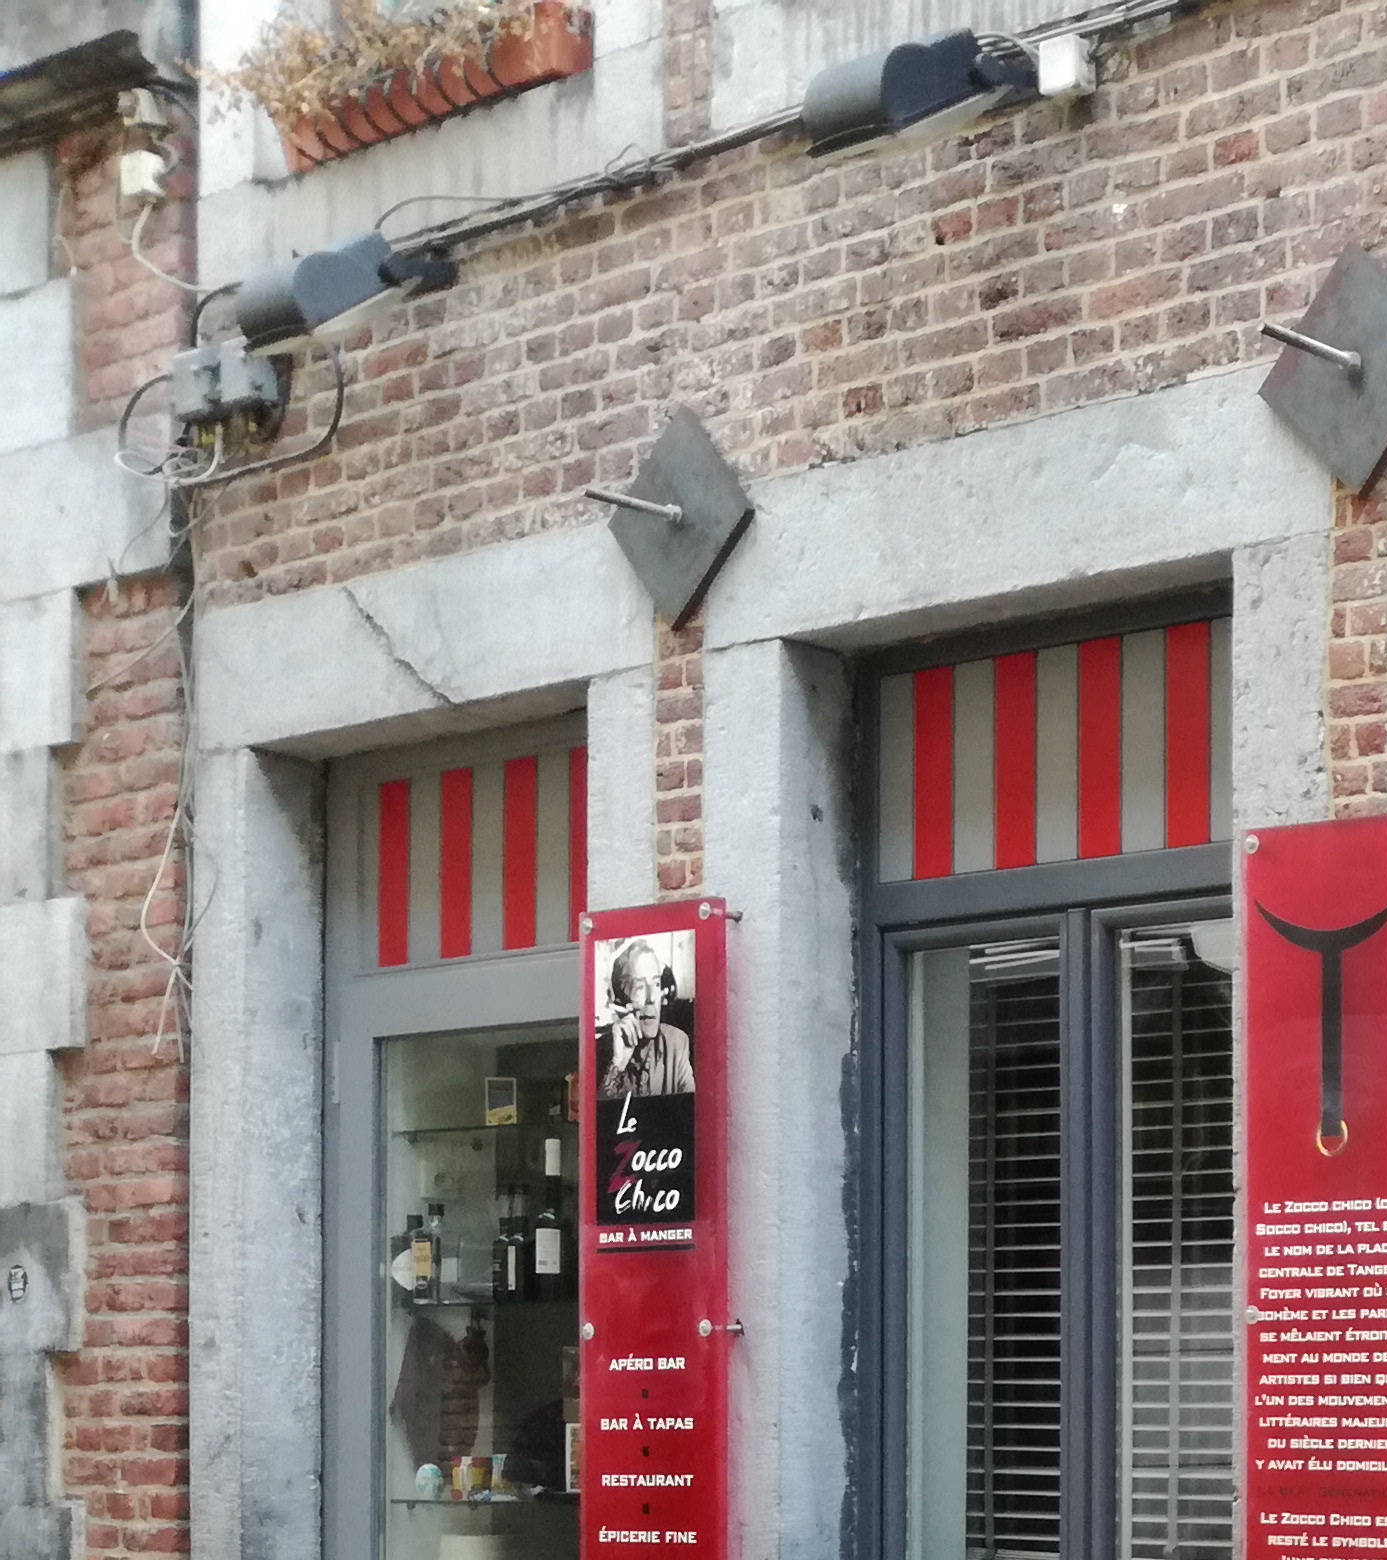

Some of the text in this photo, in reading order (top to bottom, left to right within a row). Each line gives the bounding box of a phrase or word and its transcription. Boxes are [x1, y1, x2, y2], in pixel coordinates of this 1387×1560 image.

[1263, 1201, 1282, 1215] LE
[1283, 1200, 1329, 1214] ZOCCO
[1331, 1198, 1373, 1212] CHICO
[1255, 1223, 1302, 1236] SOCCO
[1354, 1220, 1381, 1233] TEL
[598, 1228, 693, 1244] BAR À MANGER
[1264, 1246, 1281, 1257] LE
[1282, 1245, 1313, 1257] NOM
[1315, 1244, 1335, 1256] DE
[1336, 1243, 1355, 1255] LA
[1258, 1266, 1324, 1279] CENTRALE
[1325, 1265, 1345, 1277] DE
[1259, 1287, 1302, 1300] FOYER
[1304, 1287, 1361, 1299] VIBRANT
[1362, 1282, 1383, 1298] OÙ
[1311, 1309, 1329, 1321] ET
[1331, 1308, 1357, 1320] LES
[1259, 1331, 1278, 1343] SE
[1279, 1328, 1343, 1343] MÊLAIENT
[608, 1353, 686, 1372] APÉRO BAR
[1262, 1353, 1298, 1364] MENT
[1300, 1352, 1320, 1364] AU
[1322, 1352, 1370, 1364] MONDE
[1258, 1374, 1320, 1385] ARTISTES
[1323, 1374, 1338, 1385] SI
[1340, 1373, 1372, 1385] BIEN
[1287, 1395, 1315, 1407] DES
[600, 1412, 694, 1431] BAR À TAPAS
[1258, 1413, 1338, 1428] LITTÉRAIRES
[1267, 1438, 1287, 1449] DU
[1289, 1434, 1335, 1450] SIÈCLE
[1255, 1459, 1265, 1470] Y
[1267, 1459, 1305, 1471] AVAIT
[1307, 1455, 1333, 1471] ÉLU
[601, 1474, 694, 1487] RESTAURANT
[1260, 1512, 1278, 1525] LE
[1280, 1512, 1326, 1526] ZOCCO
[1329, 1513, 1372, 1527] CHICO
[598, 1526, 697, 1544] ÉPICERIE FINE
[1267, 1532, 1309, 1547] RESTÉ
[1311, 1536, 1329, 1547] LE
